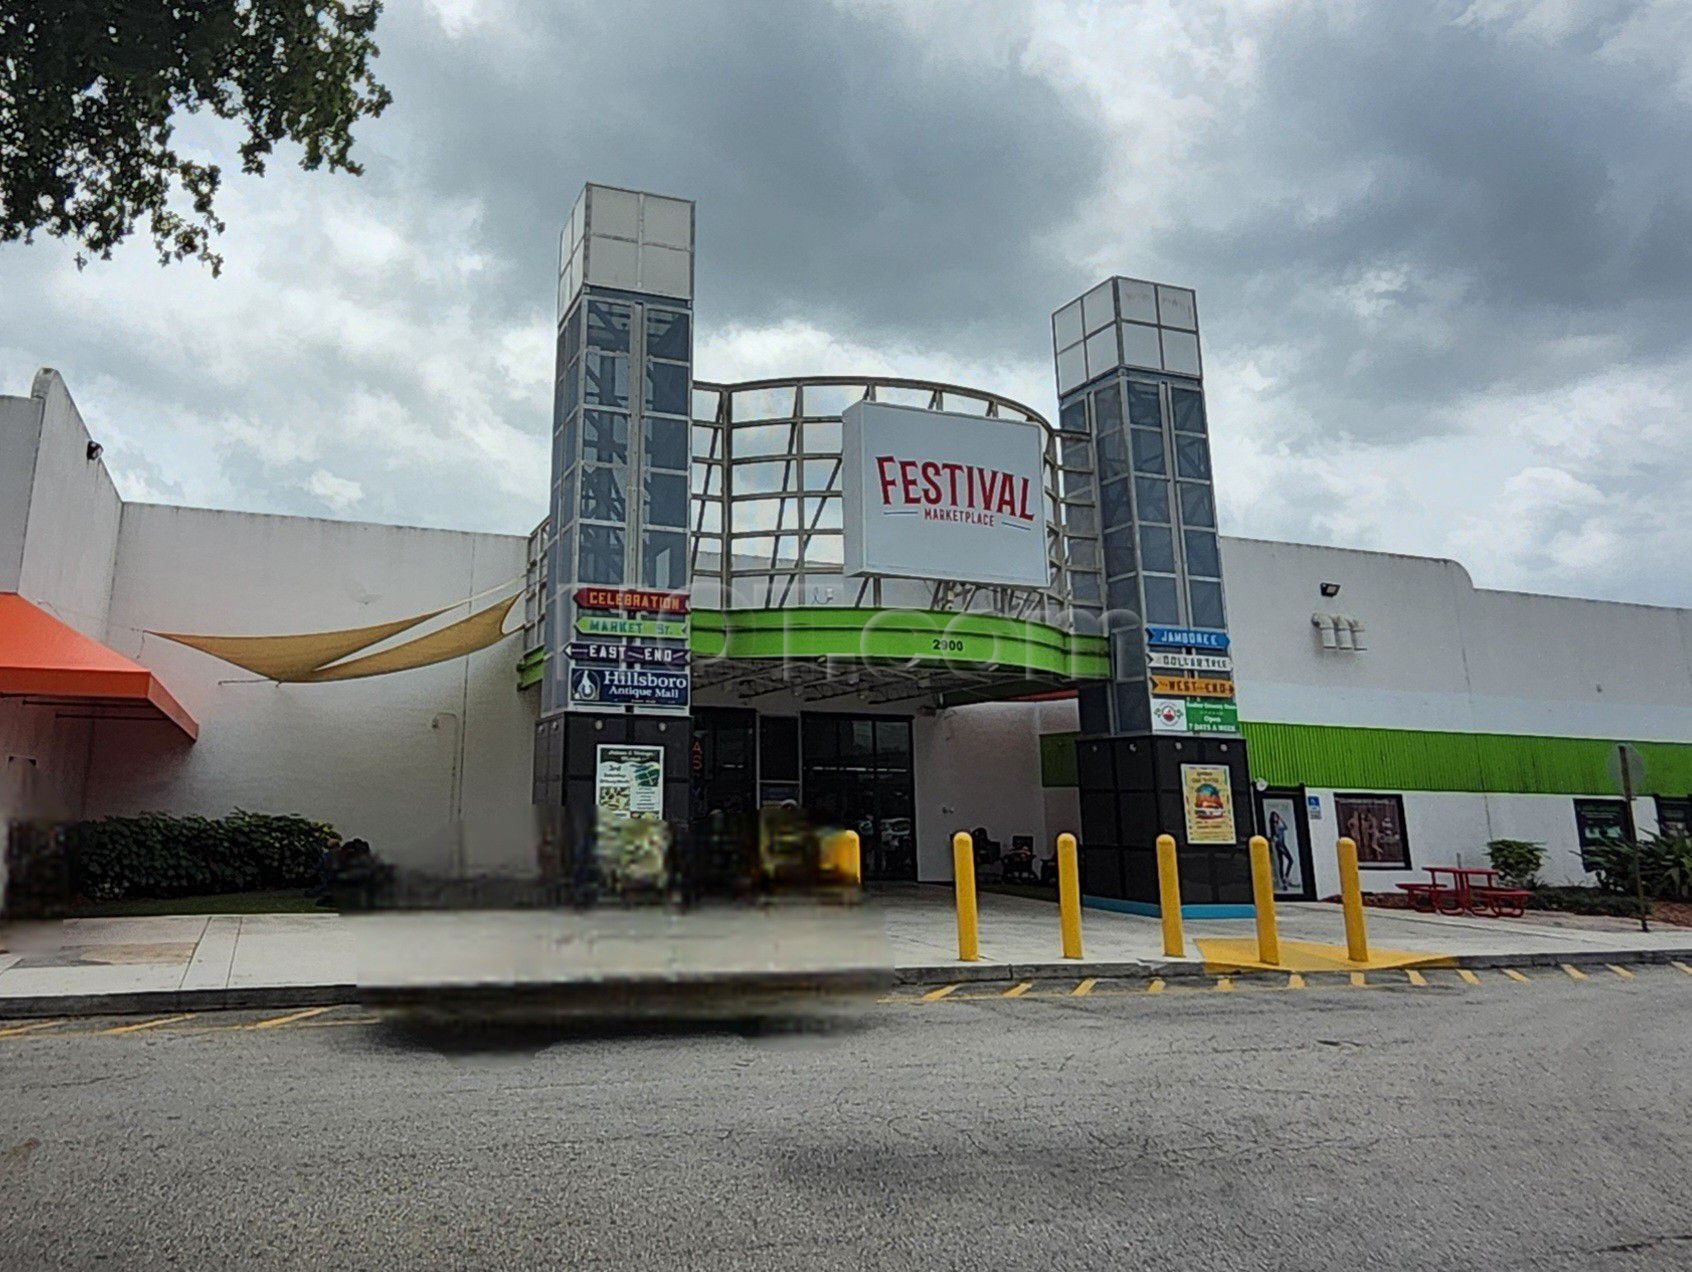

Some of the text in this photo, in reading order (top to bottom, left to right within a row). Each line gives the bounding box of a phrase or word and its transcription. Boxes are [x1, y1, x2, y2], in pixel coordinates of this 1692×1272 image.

[875, 455, 1035, 522] FESTIVAL
[924, 509, 995, 527] MARKETPLACE
[589, 592, 680, 609] CELEBRATION
[589, 620, 643, 633] MARKET
[932, 638, 964, 651] 2900
[1161, 631, 1217, 645] JAMBOREE
[589, 645, 672, 661] EAST END
[1162, 655, 1202, 668] DOLLAR
[603, 670, 687, 689] Hillsboro
[608, 686, 680, 699] Antique Mall
[1168, 680, 1227, 694] WEST END
